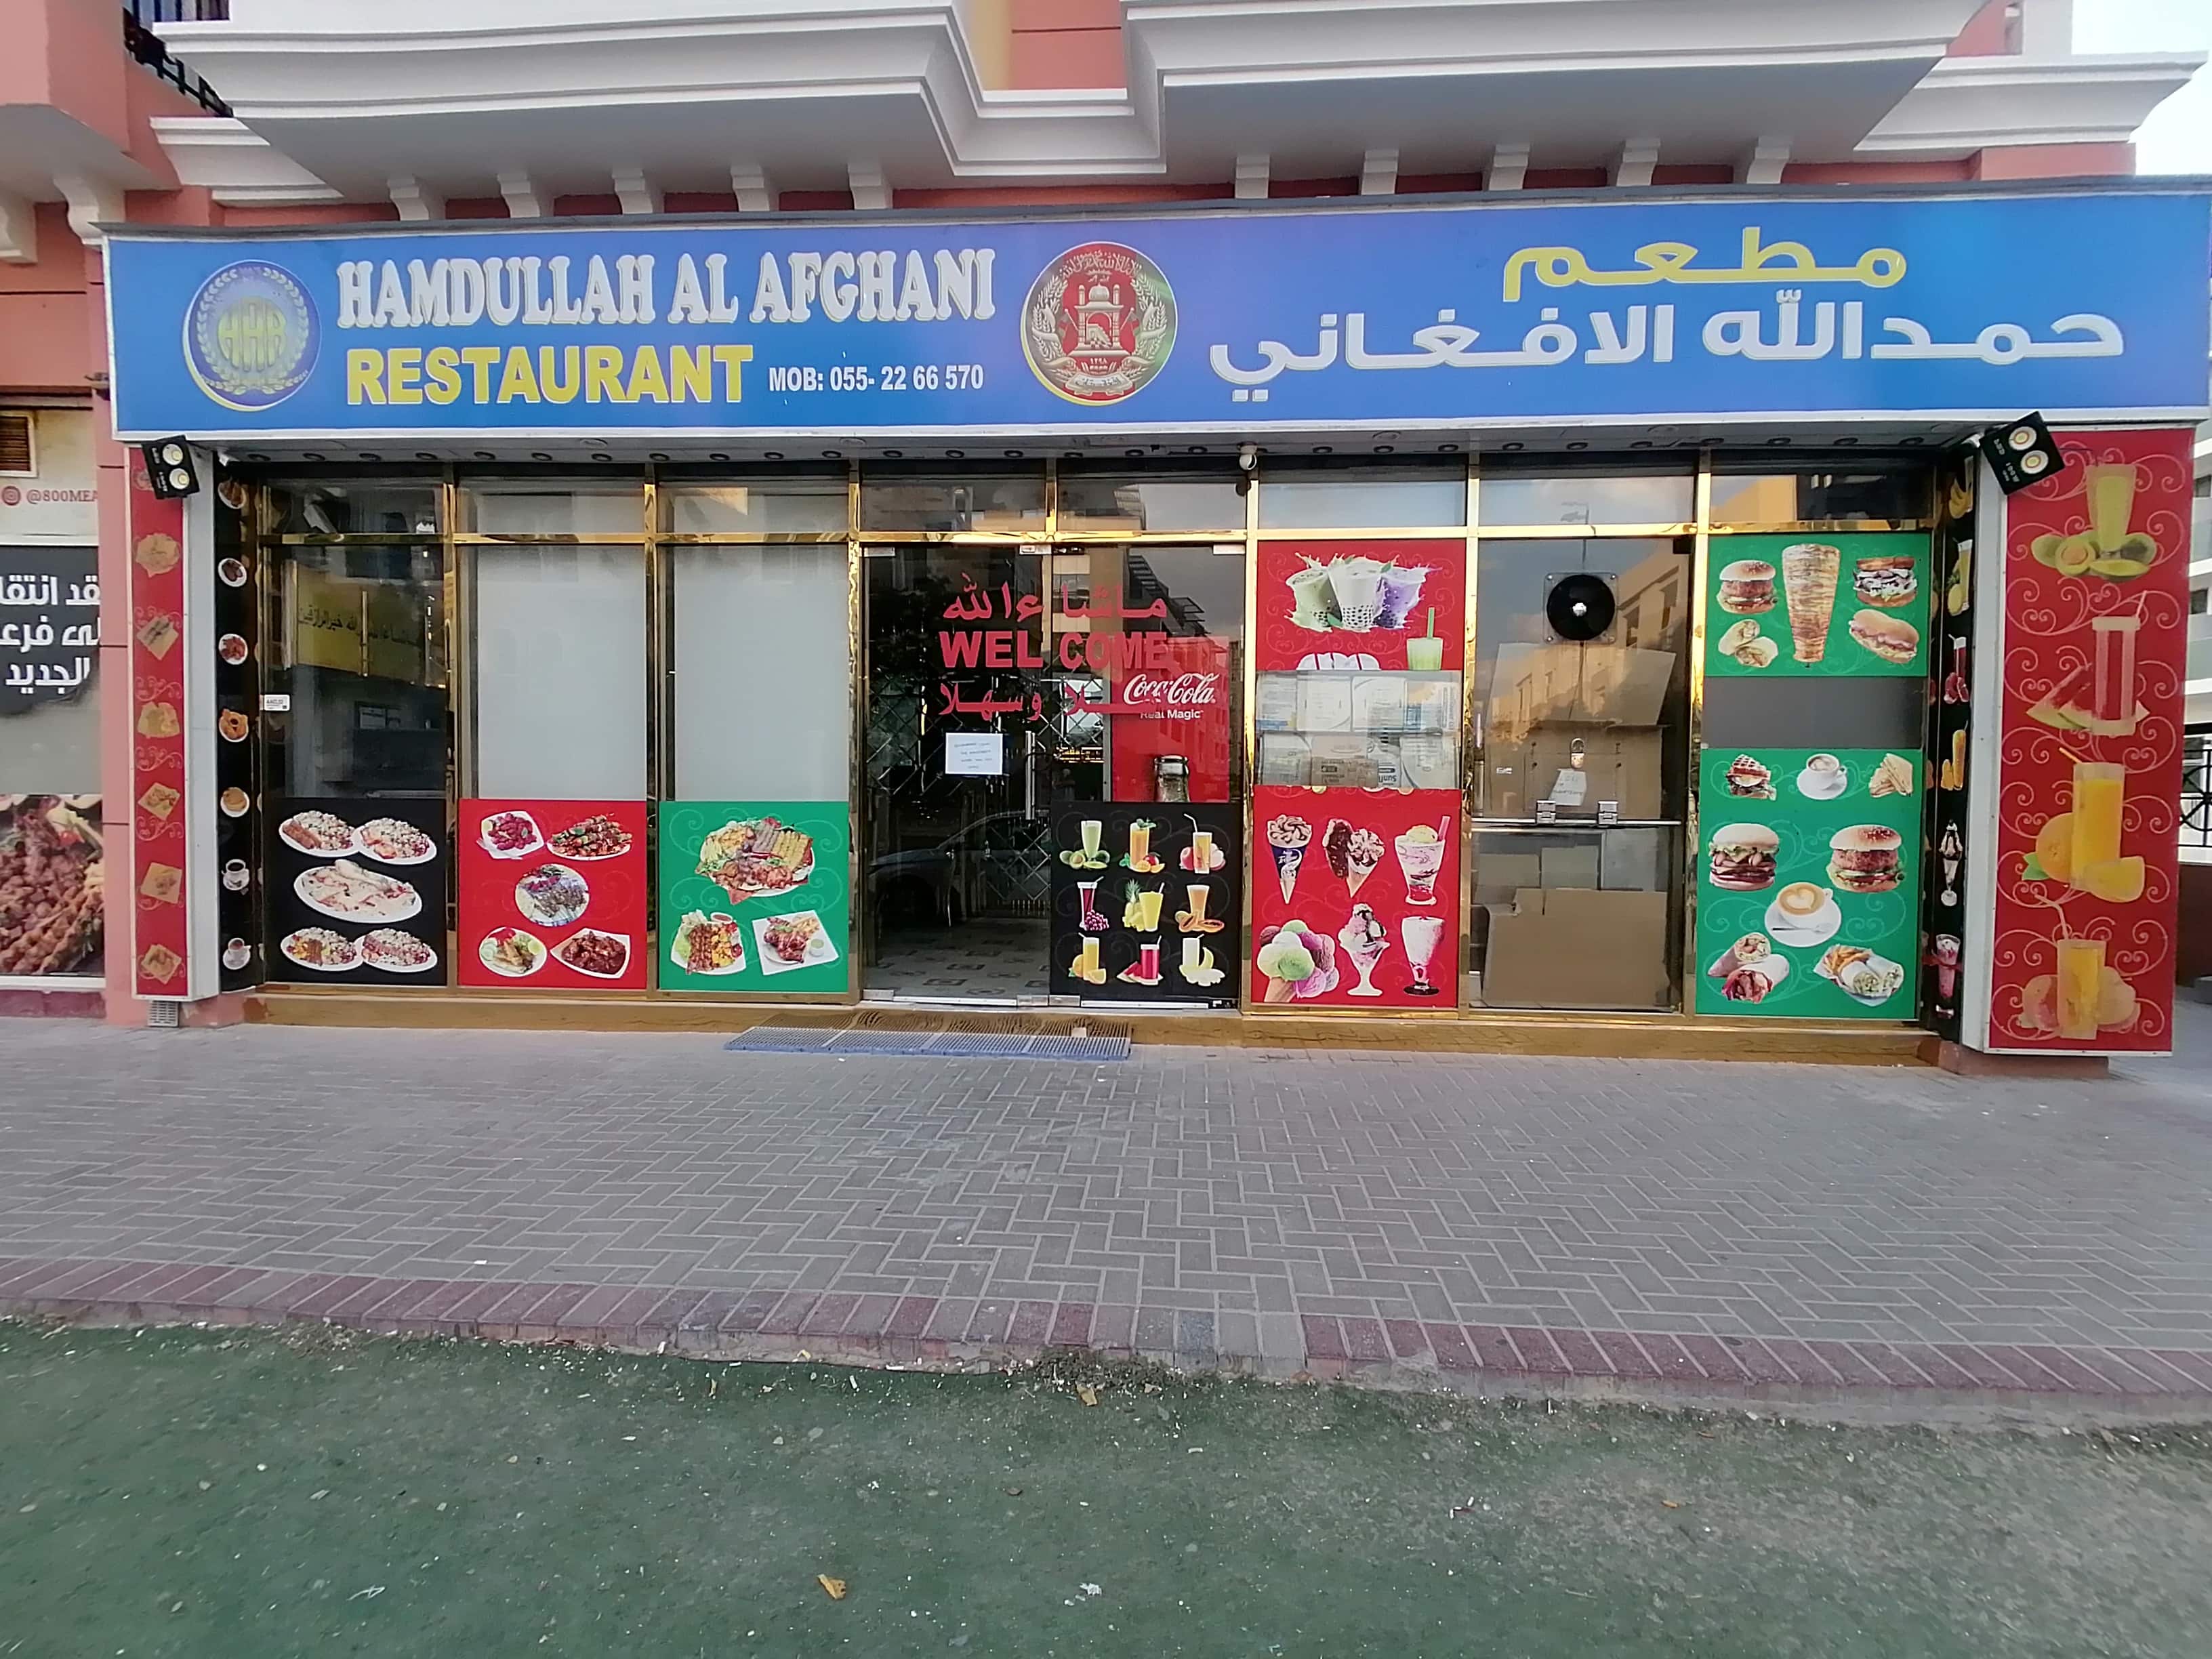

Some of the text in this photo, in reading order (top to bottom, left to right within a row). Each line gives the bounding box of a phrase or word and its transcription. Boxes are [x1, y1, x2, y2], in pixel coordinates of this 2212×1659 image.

[1502, 226, 1907, 302] مطعم
[336, 253, 656, 328] HAMDULLAH
[668, 252, 739, 325] AL
[749, 247, 996, 323] AFGHANI
[346, 344, 754, 405] RESTAURANT
[769, 364, 984, 392] MOB: 055- 22 66 570
[65, 575, 100, 606] قد
[0, 615, 54, 653] فرع
[5, 657, 91, 695] الجديد
[1124, 673, 1220, 705] Coca-Cola
